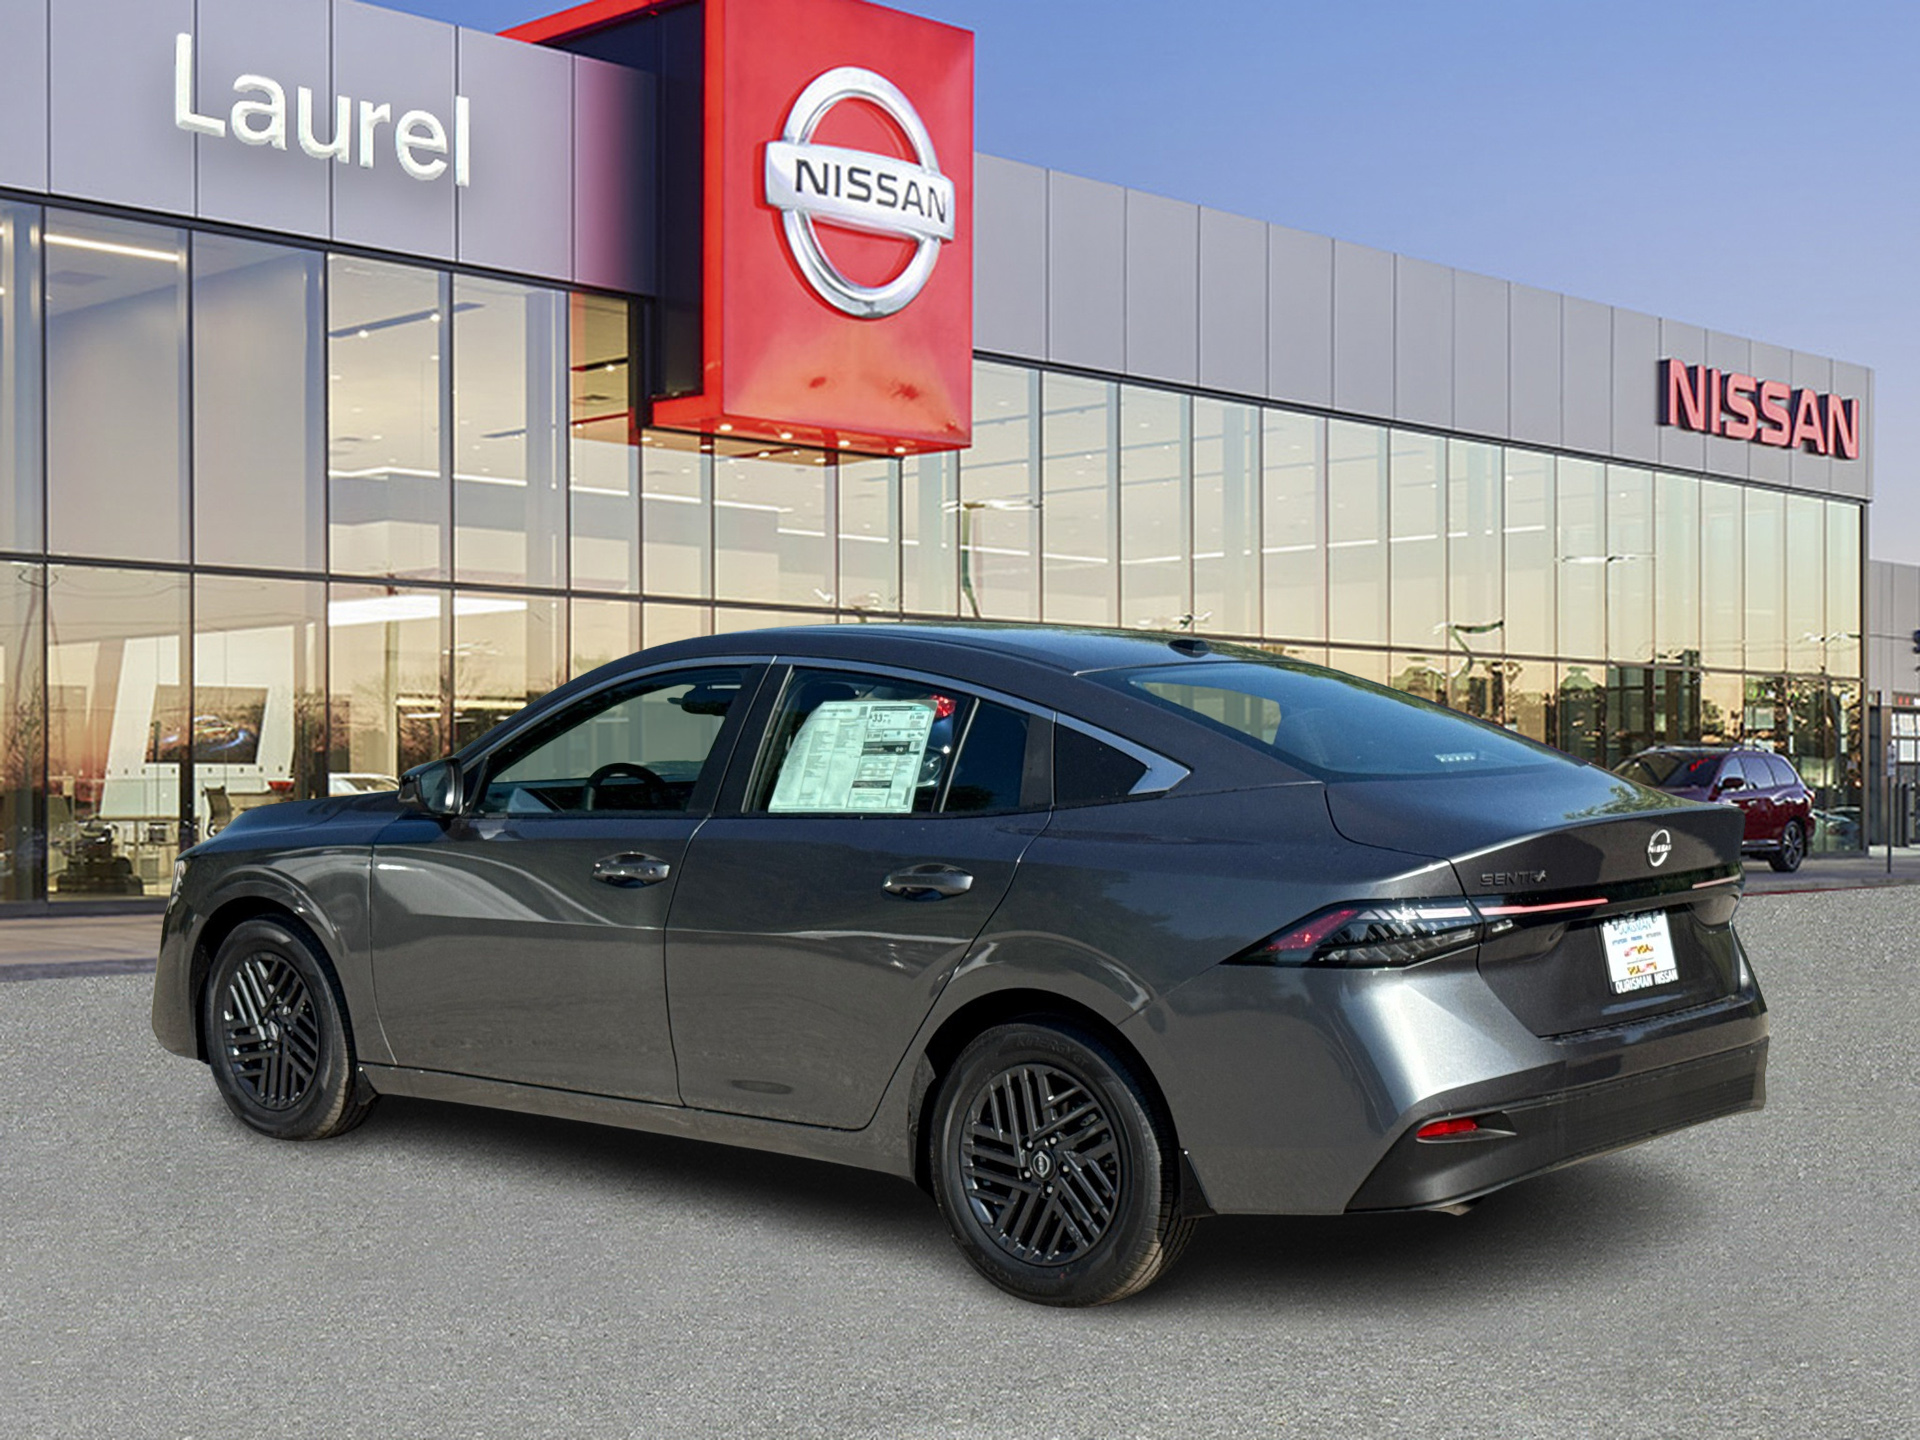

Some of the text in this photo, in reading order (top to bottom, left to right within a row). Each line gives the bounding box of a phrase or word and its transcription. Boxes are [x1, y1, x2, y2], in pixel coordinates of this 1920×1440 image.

[175, 33, 470, 187] Laurel
[794, 158, 948, 224] NISSAN
[1658, 357, 1860, 460] NISSAN
[1480, 869, 1547, 887] SENTRA
[1615, 968, 1679, 994] OURISMAN NISSAN
